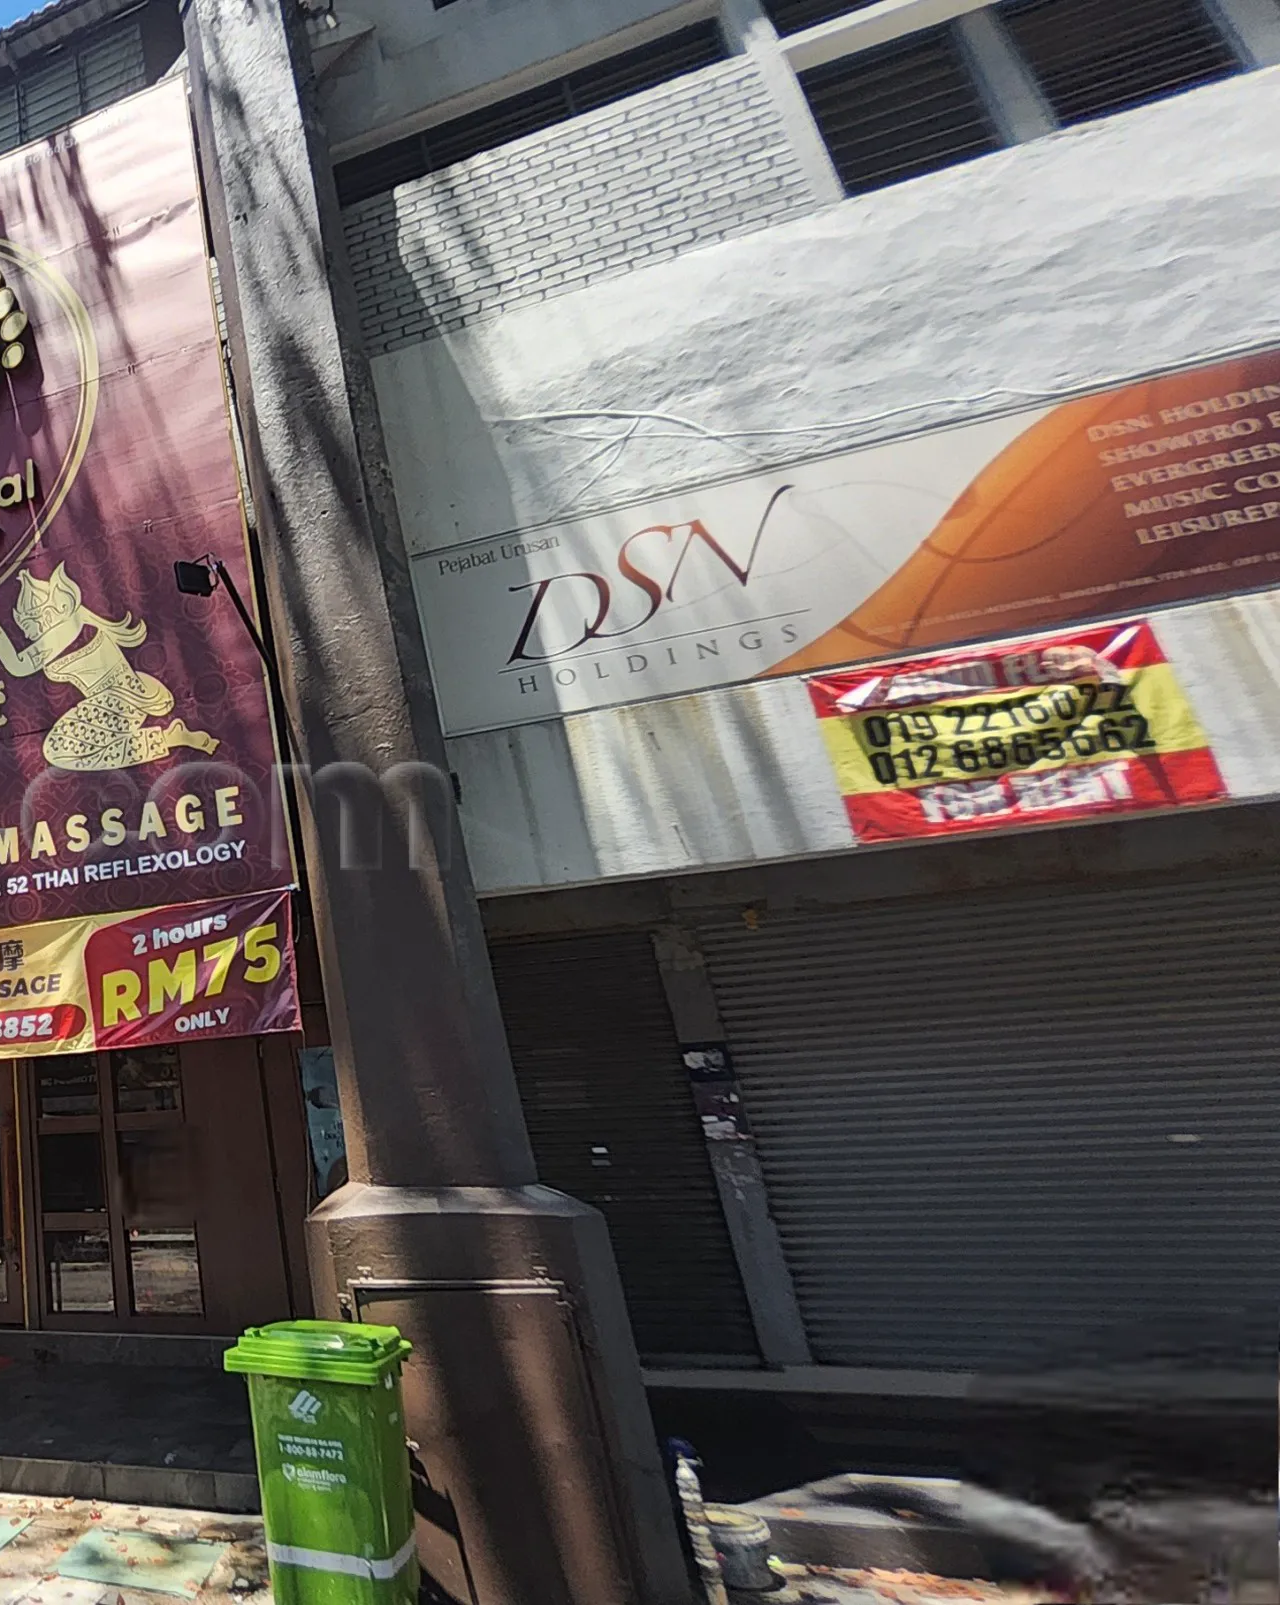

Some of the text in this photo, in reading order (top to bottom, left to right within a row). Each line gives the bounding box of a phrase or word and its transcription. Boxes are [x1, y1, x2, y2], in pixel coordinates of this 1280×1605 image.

[1086, 413, 1155, 443] DSN
[1098, 417, 1265, 468] SHOWPRO
[1123, 482, 1233, 519] MUSIC
[437, 534, 561, 577] Pejabat Urusan
[506, 484, 796, 665] DSN
[518, 622, 800, 695] HOLDINGS
[864, 711, 939, 748] 019
[868, 713, 1156, 786] 012 6865662
[6, 876, 29, 895] 52
[32, 869, 80, 891] THAI
[84, 840, 246, 884] REFLEXOLOGY
[130, 911, 228, 957] 2 hours
[100, 922, 282, 1028] RM75
[173, 1006, 231, 1034] ONLY
